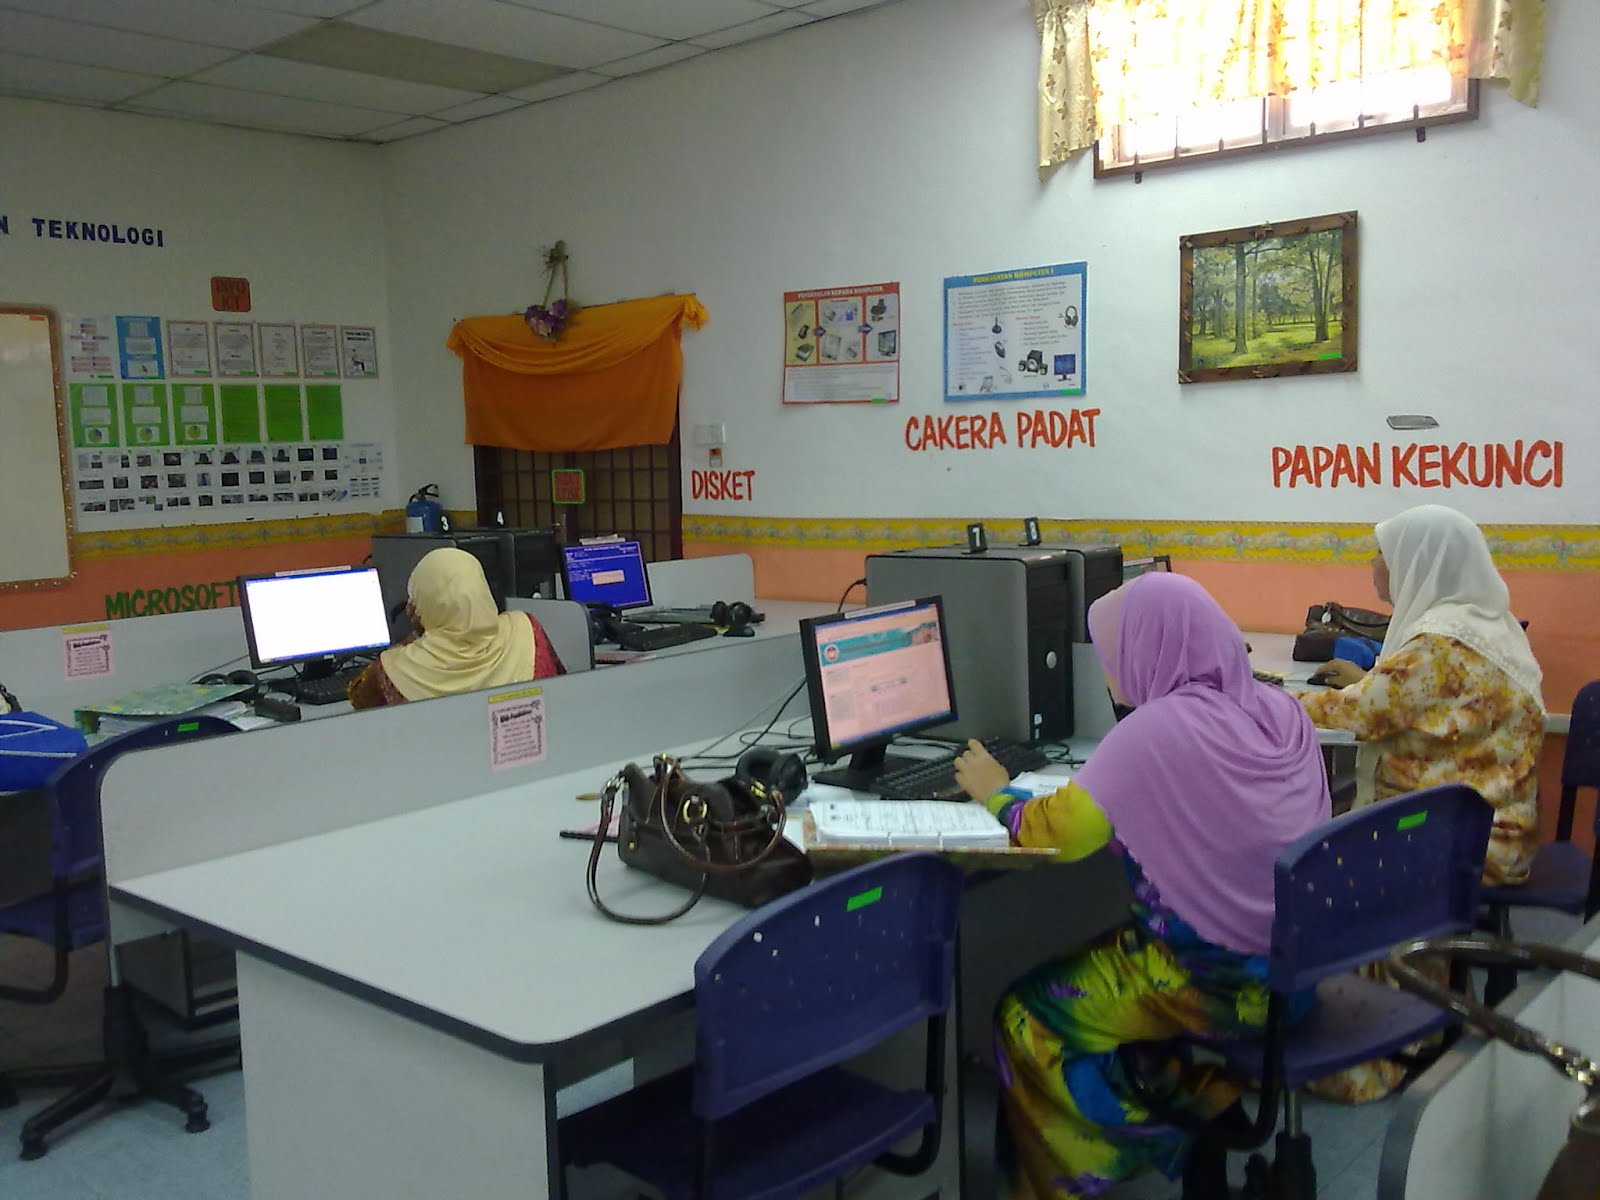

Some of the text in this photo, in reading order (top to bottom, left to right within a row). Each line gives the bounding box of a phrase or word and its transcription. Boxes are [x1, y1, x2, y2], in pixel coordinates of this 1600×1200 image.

[32, 218, 164, 248] TEKNOLOGI
[905, 408, 1101, 451] CAKERA PADAT
[1272, 440, 1563, 489] PAPAN KEKUNCI
[691, 470, 756, 502] DISKET
[440, 515, 449, 531] 3
[497, 511, 504, 525] 4
[972, 527, 980, 547] 1
[104, 580, 237, 620] MICROSOFT
